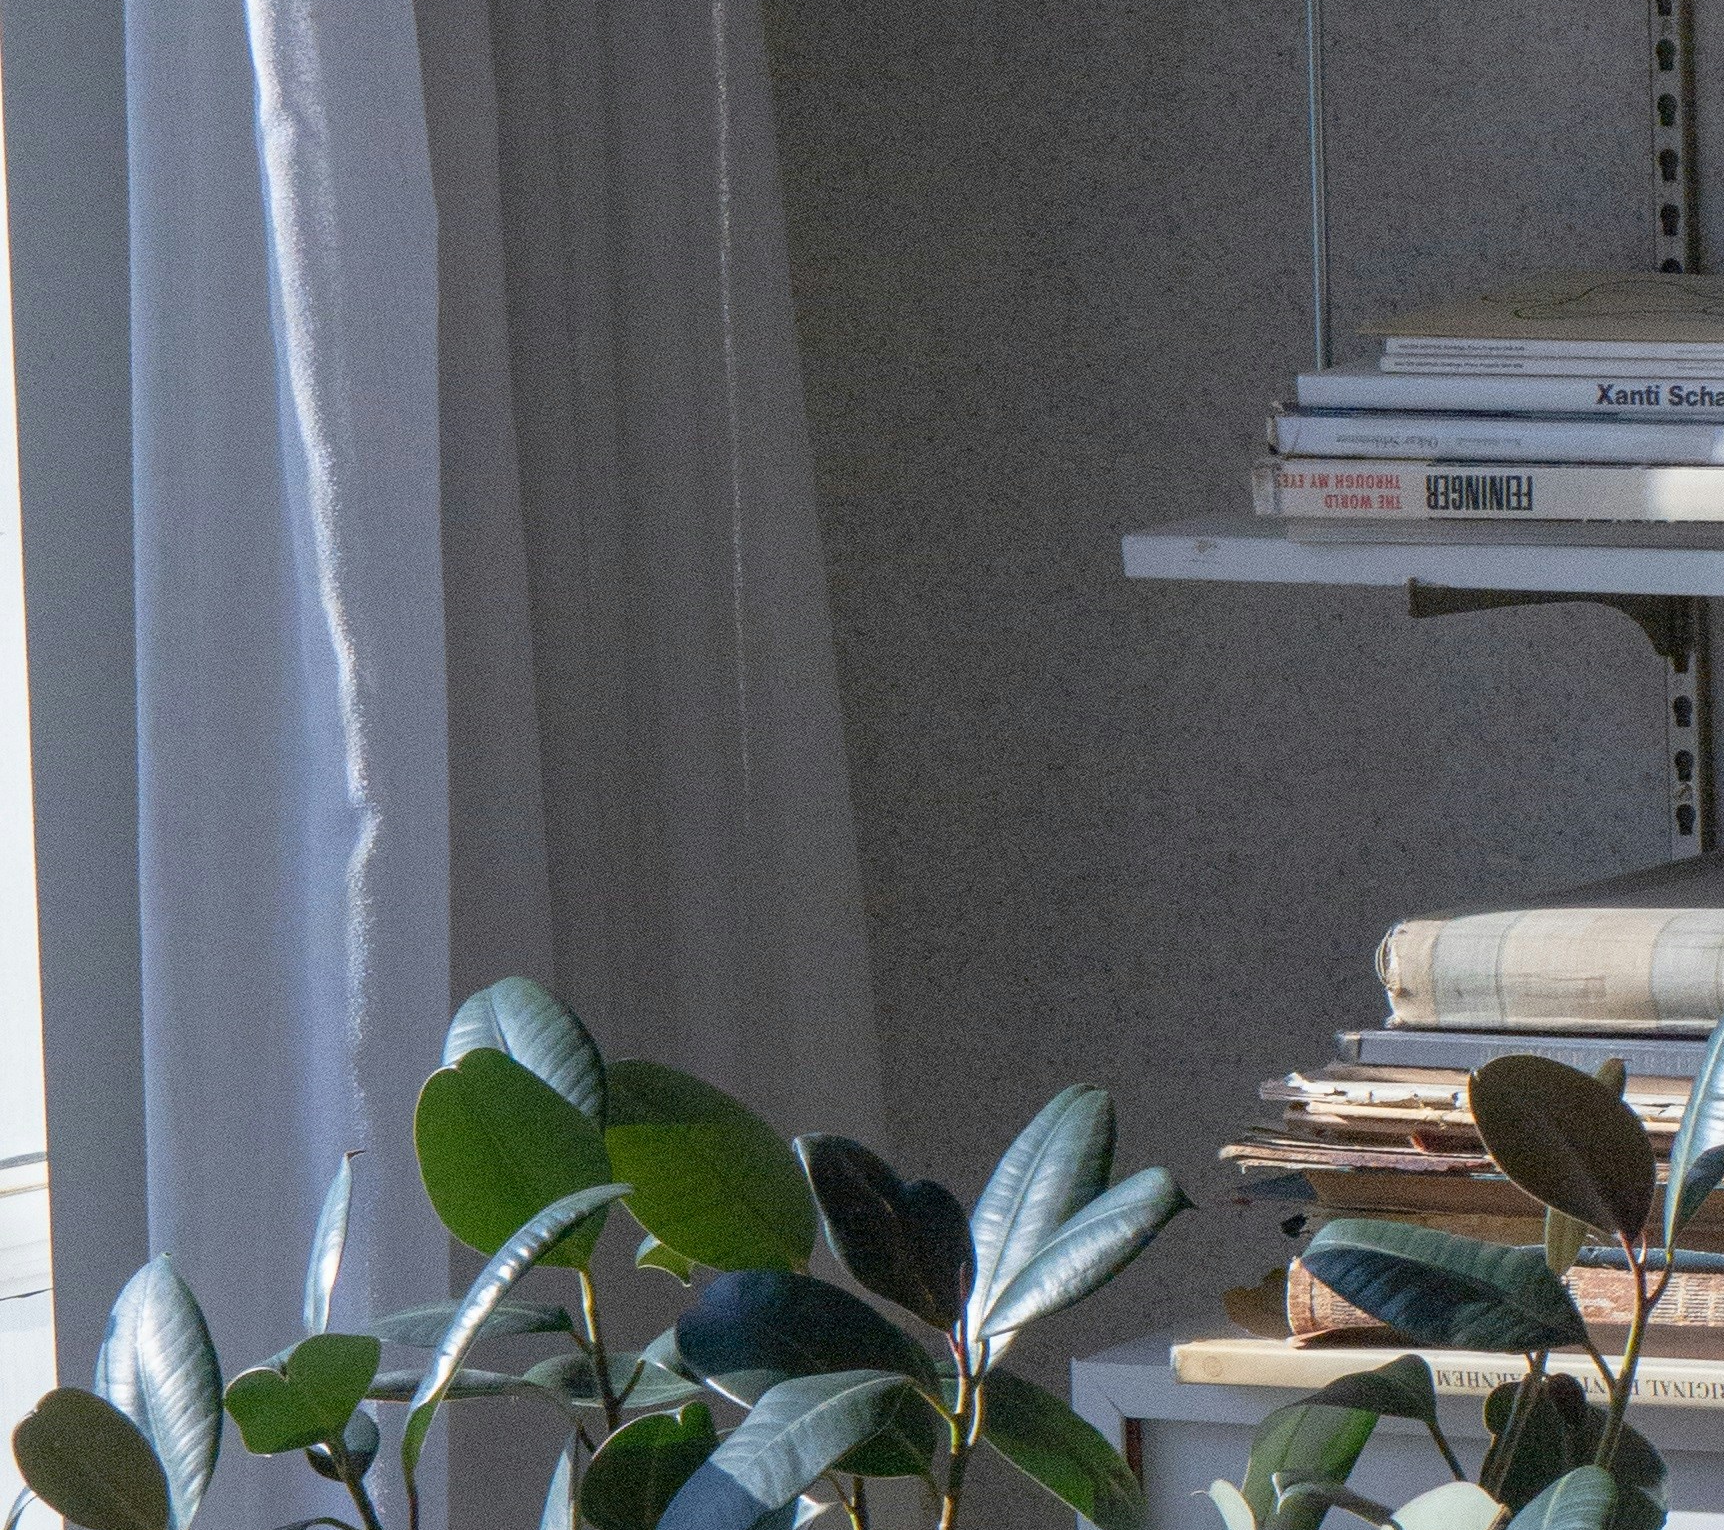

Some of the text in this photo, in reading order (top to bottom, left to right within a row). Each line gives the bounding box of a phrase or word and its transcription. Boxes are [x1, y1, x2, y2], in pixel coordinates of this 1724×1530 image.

[1595, 383, 1662, 408] Xanti
[1335, 473, 1401, 490] THROUGH
[1324, 493, 1402, 509] THE WORLD
[1425, 474, 1534, 512] FEININGER
